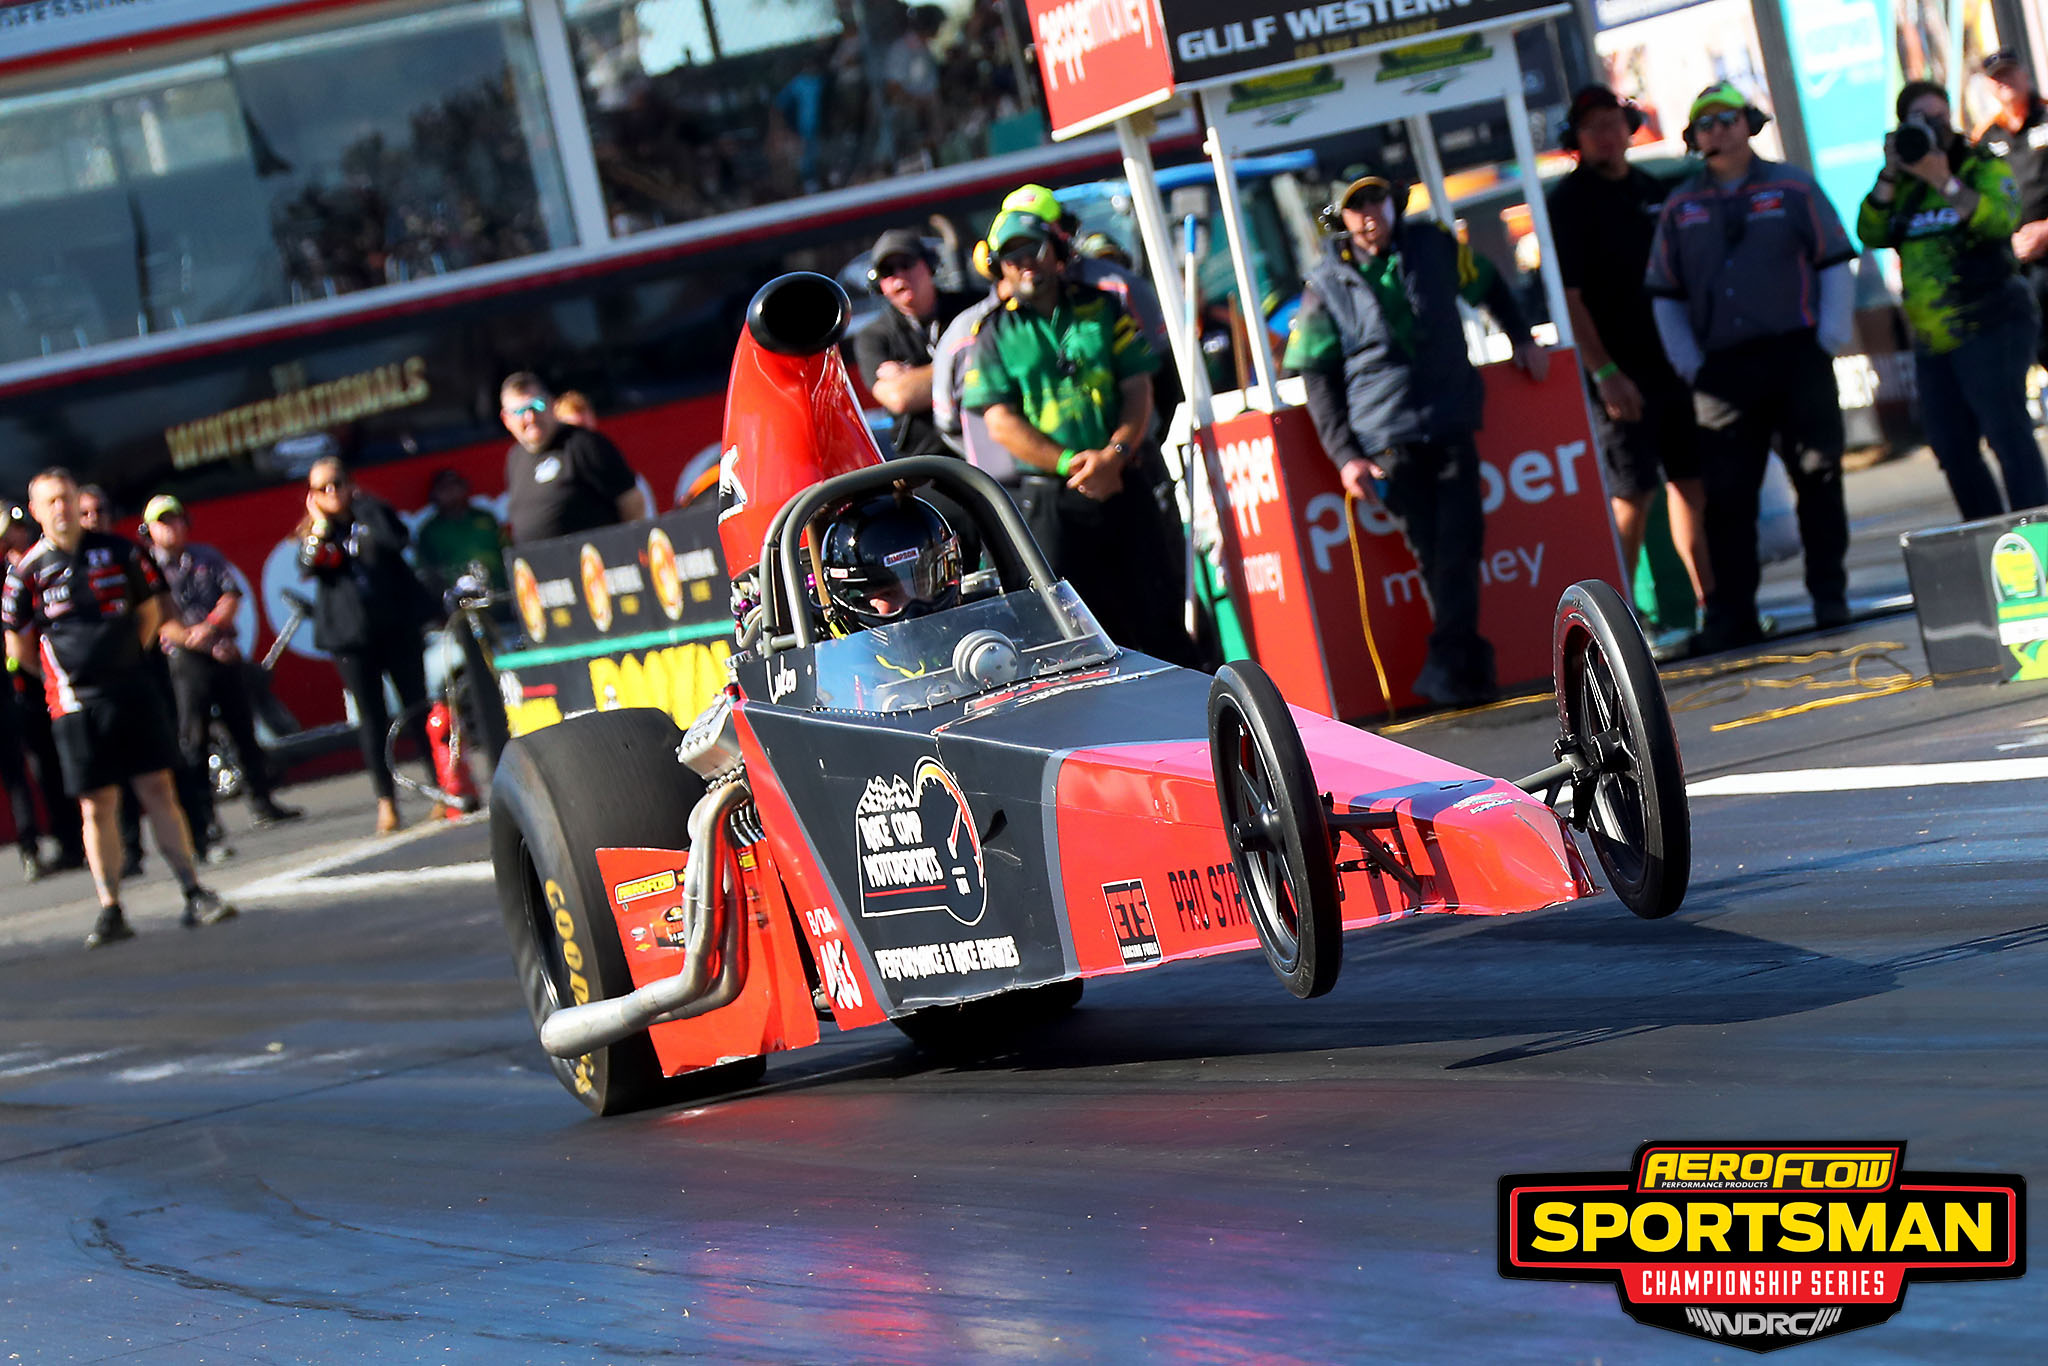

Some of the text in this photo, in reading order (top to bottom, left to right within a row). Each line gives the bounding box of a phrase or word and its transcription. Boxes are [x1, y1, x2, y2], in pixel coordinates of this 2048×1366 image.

[1177, 16, 1277, 62] GULF
[1382, 542, 1544, 606] mey
[858, 810, 923, 852] RACE COMP
[862, 846, 944, 888] MOTORSPORTS
[1107, 888, 1154, 939] ETS
[1168, 862, 1256, 932] PRO STR
[805, 906, 837, 938] B/DA
[874, 944, 946, 981] PERFORMANCE
[948, 940, 981, 975] RACE
[974, 935, 1020, 970] ENGINES
